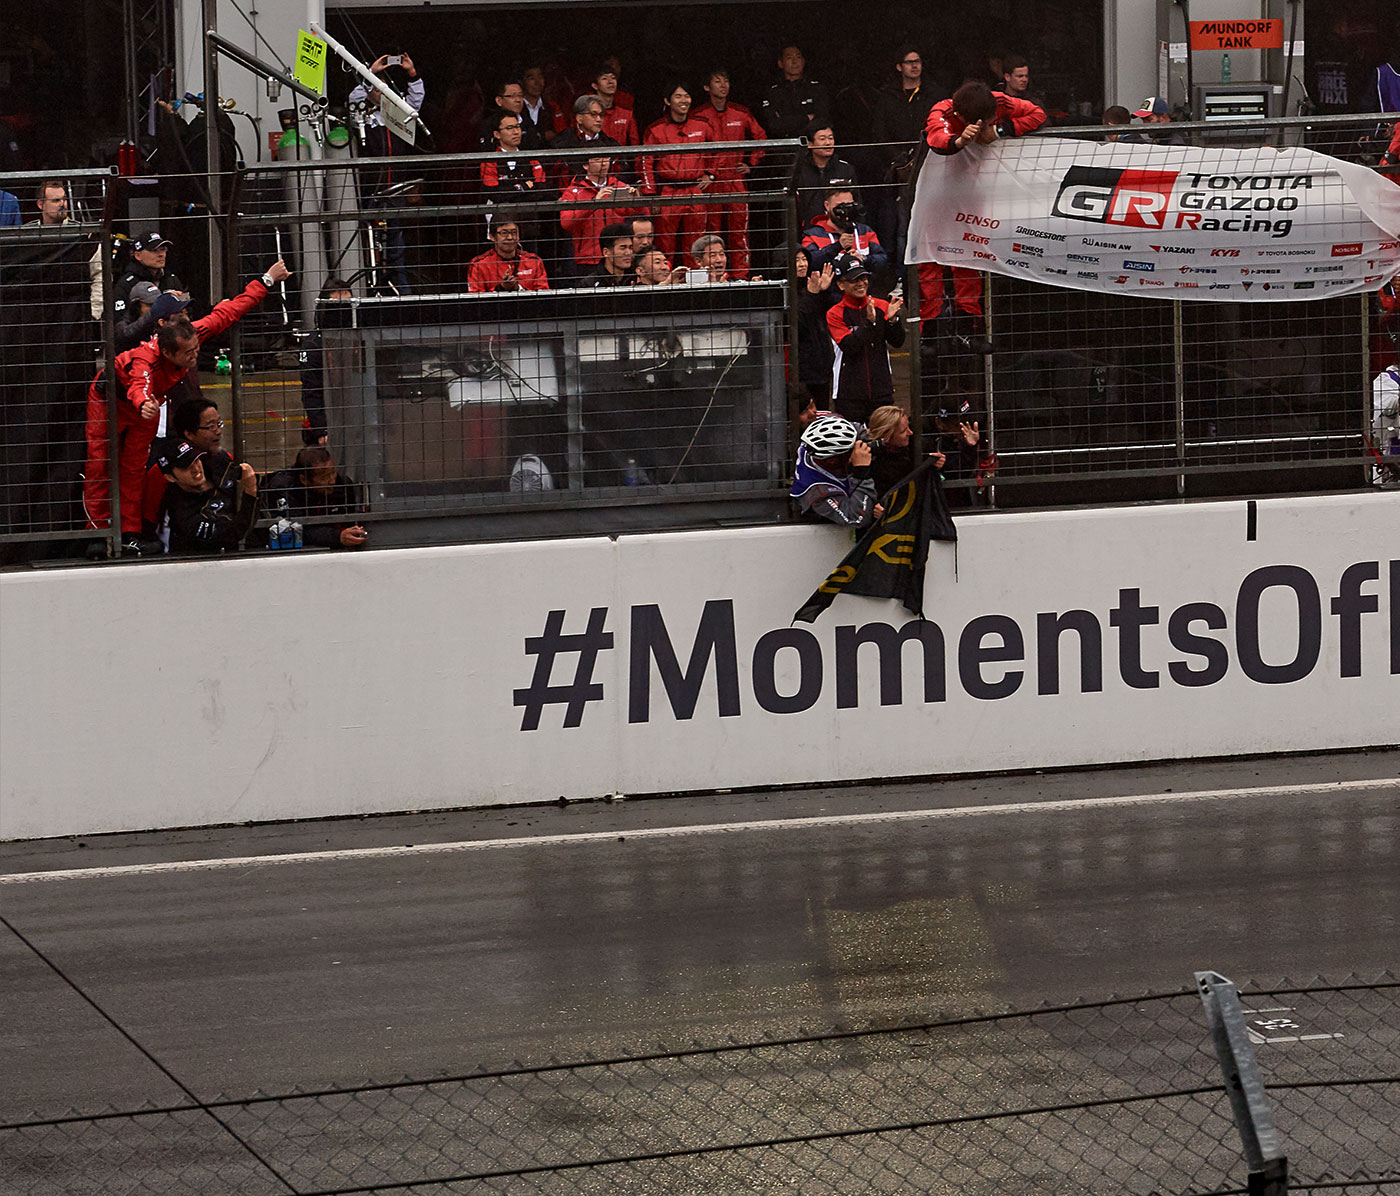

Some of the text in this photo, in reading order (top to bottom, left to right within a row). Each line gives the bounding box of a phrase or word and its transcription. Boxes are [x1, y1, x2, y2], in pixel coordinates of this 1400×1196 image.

[1199, 22, 1272, 35] MUNDORF
[1217, 36, 1253, 48] TANK
[1186, 172, 1313, 190] TOYOTA
[1057, 184, 1167, 230] GR
[1179, 192, 1298, 211] GAZOO
[955, 212, 1000, 230] DENSO
[1174, 213, 1293, 238] Racing
[1016, 225, 1067, 243] BRIDGESTONE
[1021, 244, 1044, 254] ENEOS
[1094, 241, 1117, 249] AISIN
[1162, 245, 1196, 255] YAZAKI
[972, 250, 997, 262] TOM'S
[1210, 249, 1241, 257] KYB
